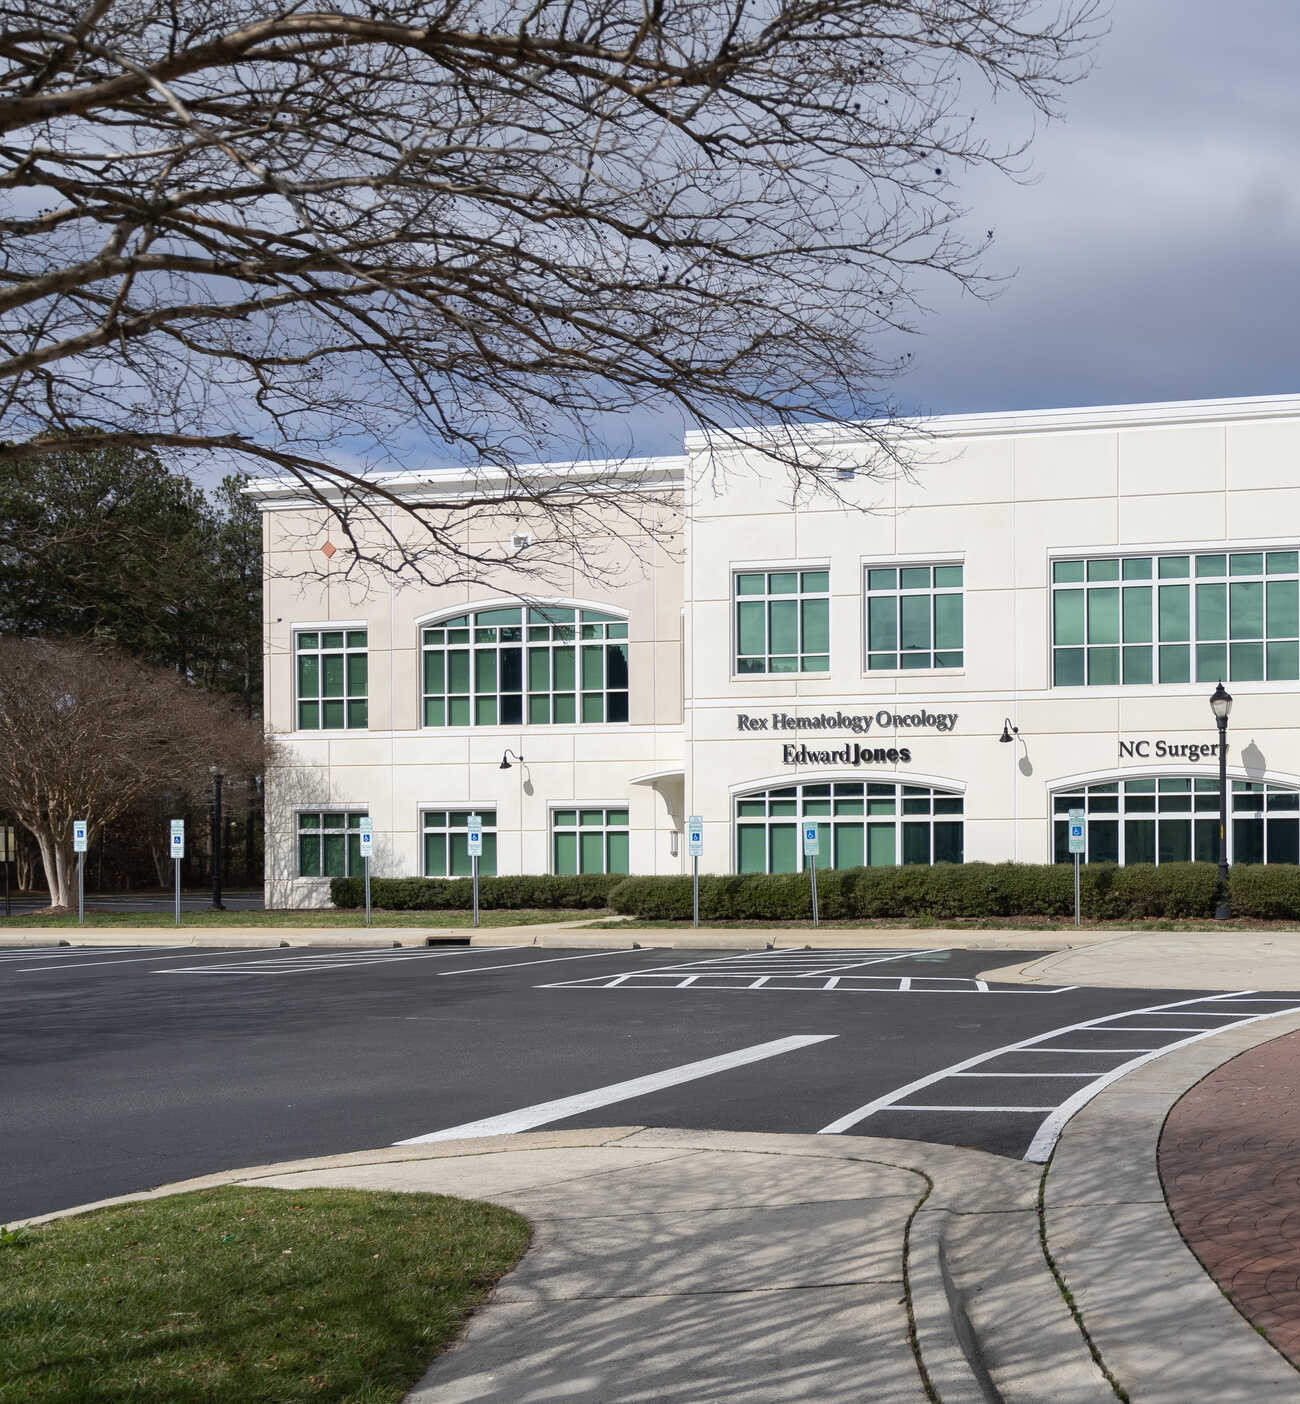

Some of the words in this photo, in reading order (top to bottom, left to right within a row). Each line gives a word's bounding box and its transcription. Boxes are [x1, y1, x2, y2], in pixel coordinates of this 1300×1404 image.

[737, 713, 768, 731] Rex
[772, 711, 874, 734] Hematology
[875, 709, 959, 731] Oncology
[1118, 740, 1150, 758] NC
